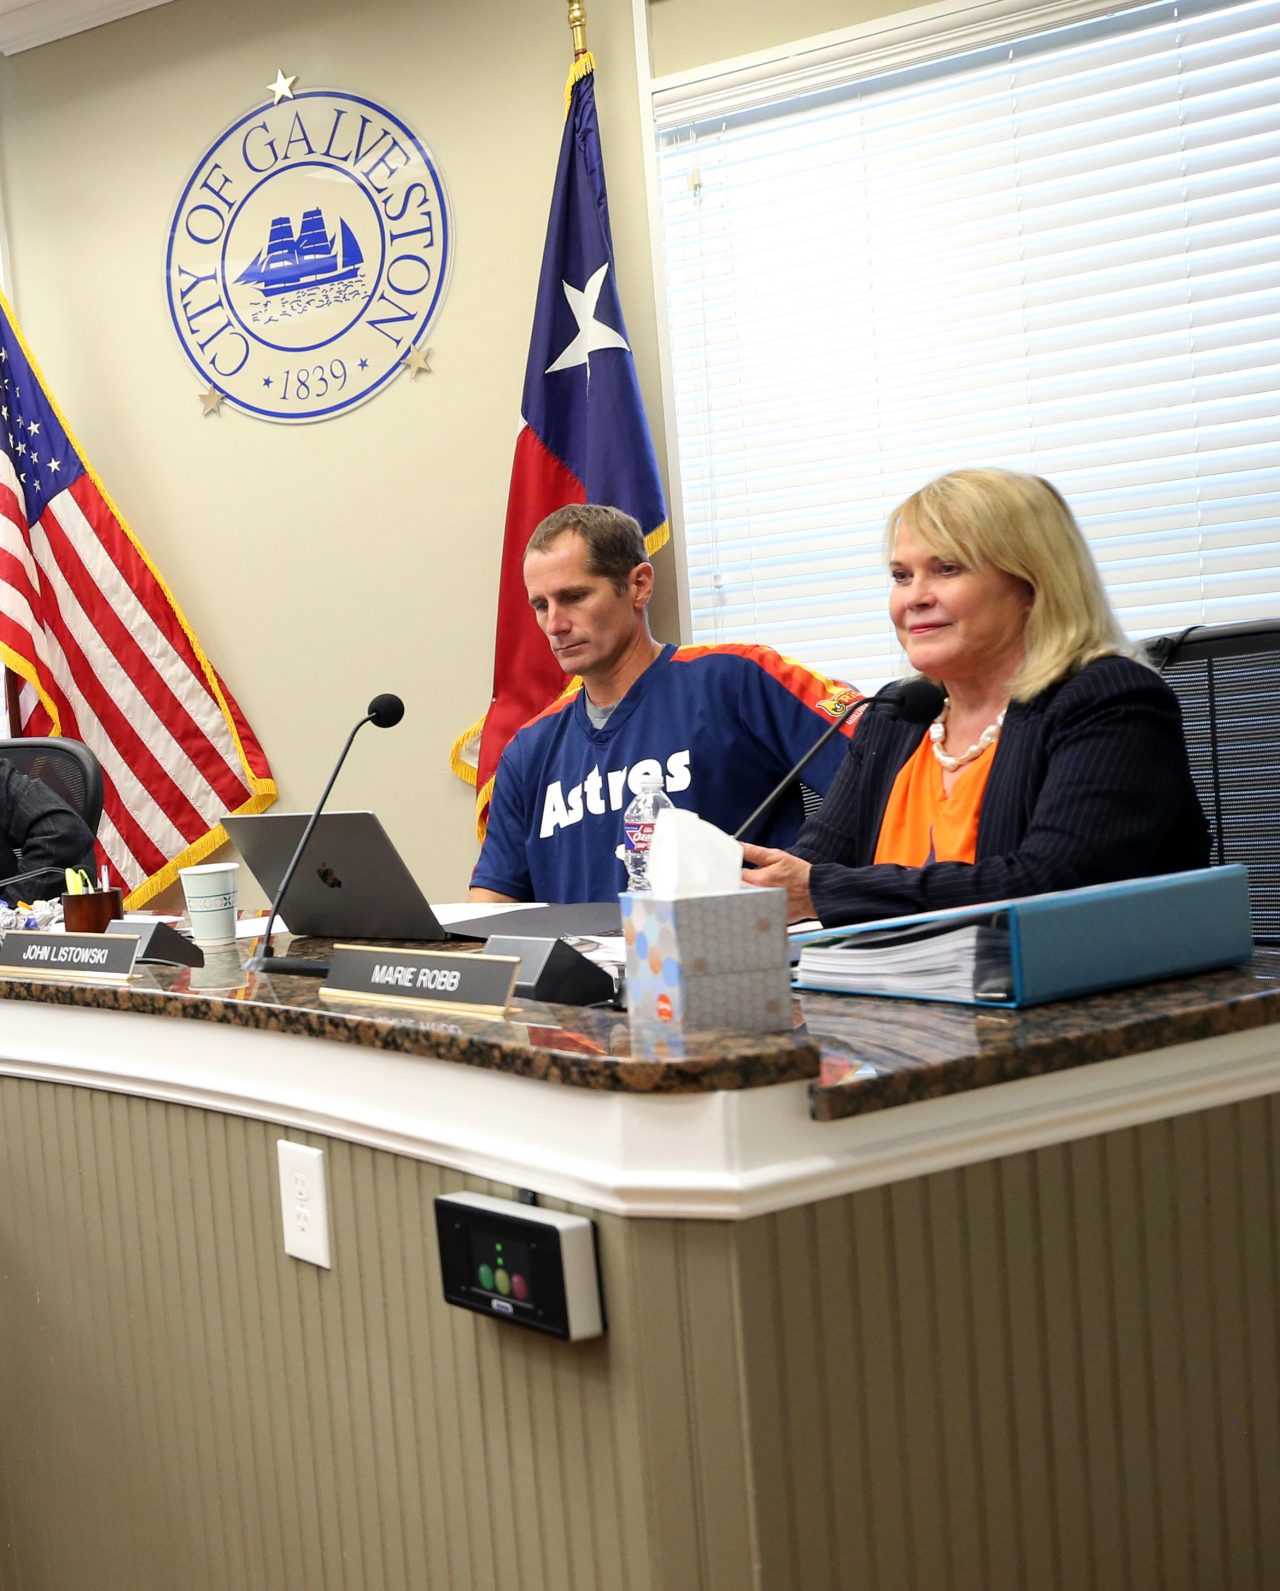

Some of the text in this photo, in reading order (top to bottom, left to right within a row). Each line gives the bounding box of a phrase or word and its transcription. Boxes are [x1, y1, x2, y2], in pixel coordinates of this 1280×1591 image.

[178, 108, 434, 379] CITY OF GALVESTON
[279, 358, 348, 400] 1839
[539, 749, 692, 839] Astros
[22, 945, 109, 964] JOHN LISTOWSKI
[370, 964, 461, 992] MARIE ROBB
